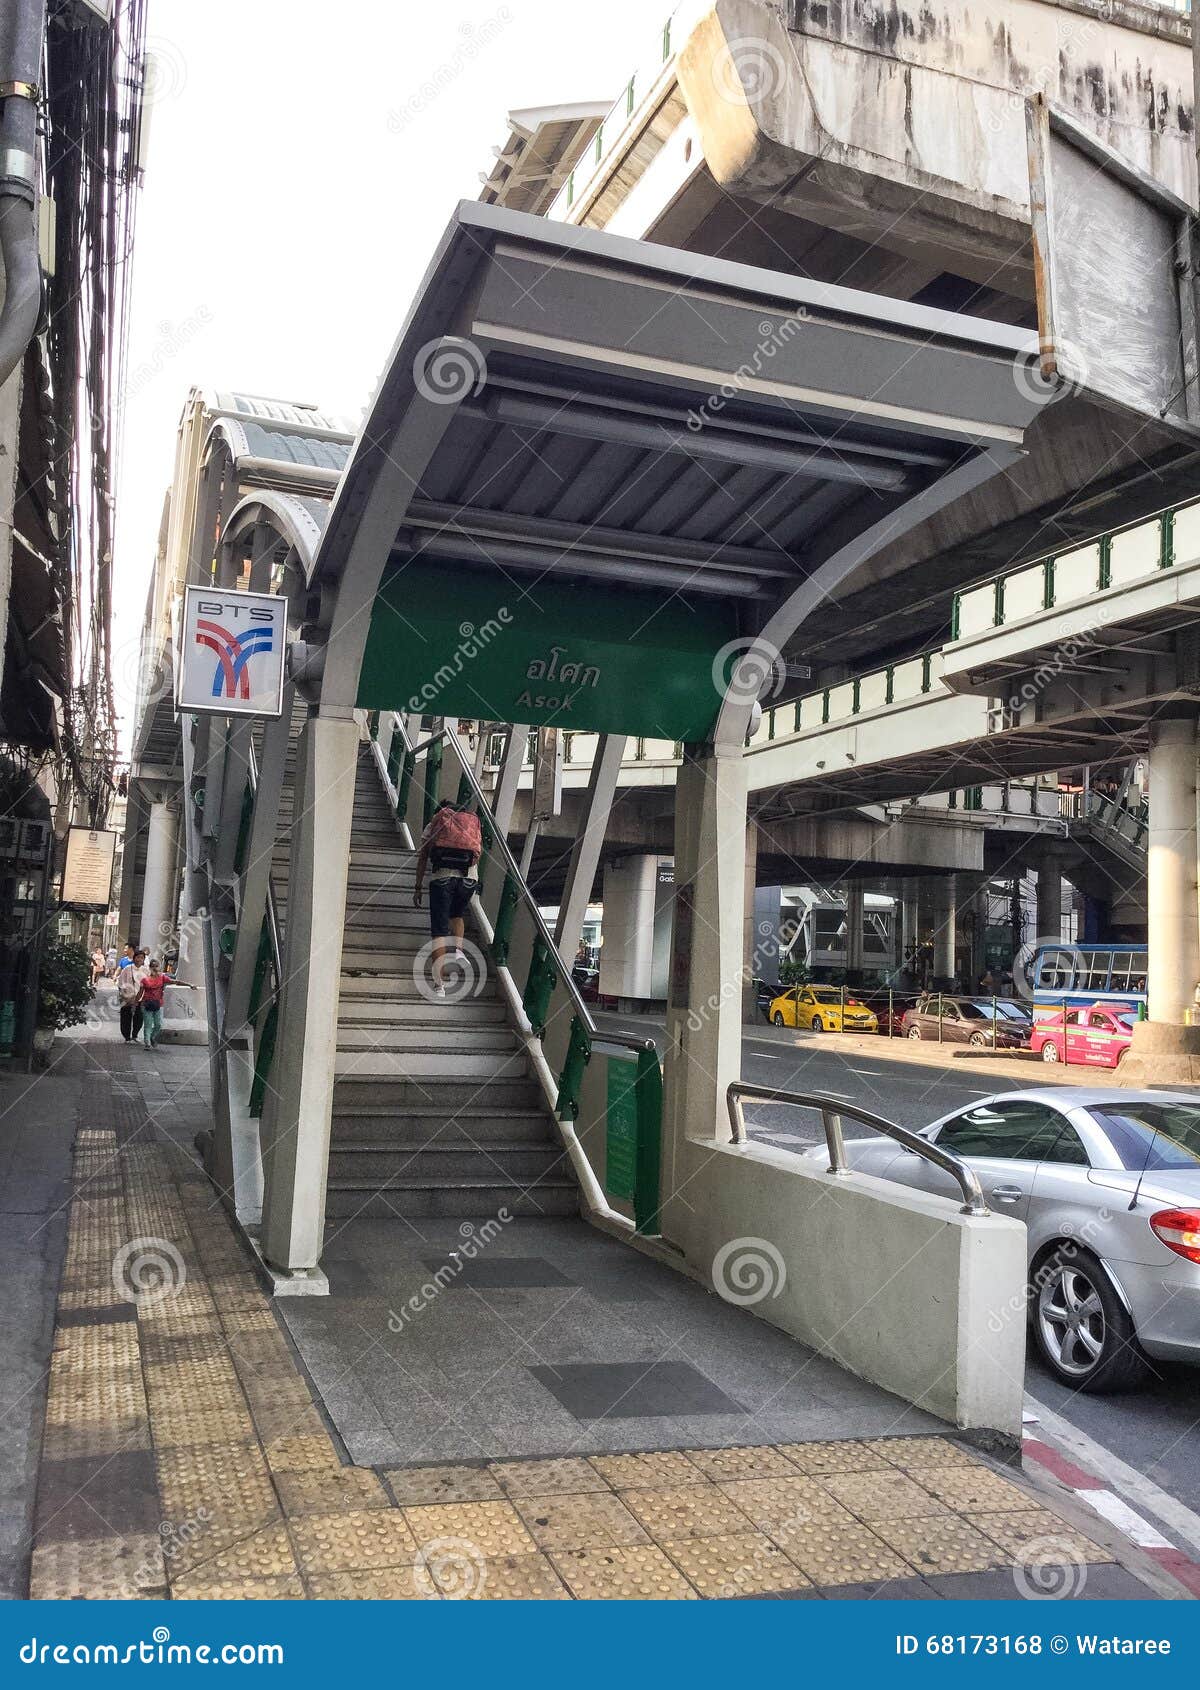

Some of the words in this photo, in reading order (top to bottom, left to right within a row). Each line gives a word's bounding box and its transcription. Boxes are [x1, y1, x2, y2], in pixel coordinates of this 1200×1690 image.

[197, 601, 275, 622] BTS
[527, 646, 601, 688] อโศก
[515, 690, 574, 712] Asok
